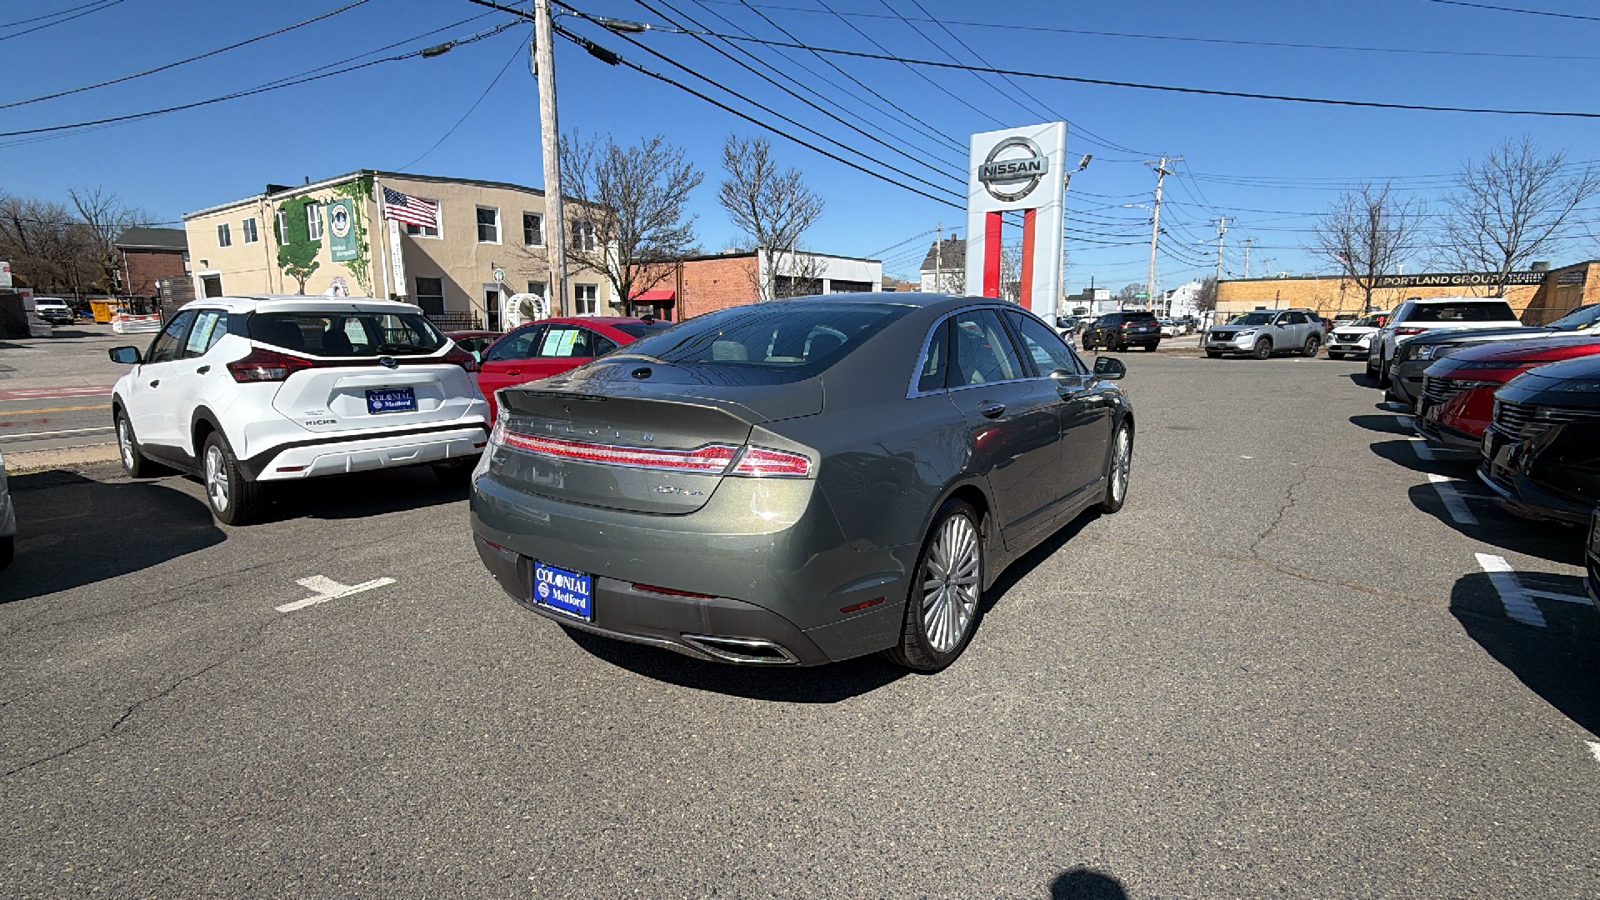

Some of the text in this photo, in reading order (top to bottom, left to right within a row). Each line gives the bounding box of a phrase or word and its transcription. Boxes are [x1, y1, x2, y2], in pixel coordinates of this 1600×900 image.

[984, 161, 1040, 176] NISSAN
[1383, 275, 1450, 287] PORTLAND
[1451, 273, 1501, 284] GROUP
[369, 392, 412, 401] COLONIAL
[536, 567, 589, 596] COLONIAL
[552, 588, 586, 609] Medford
